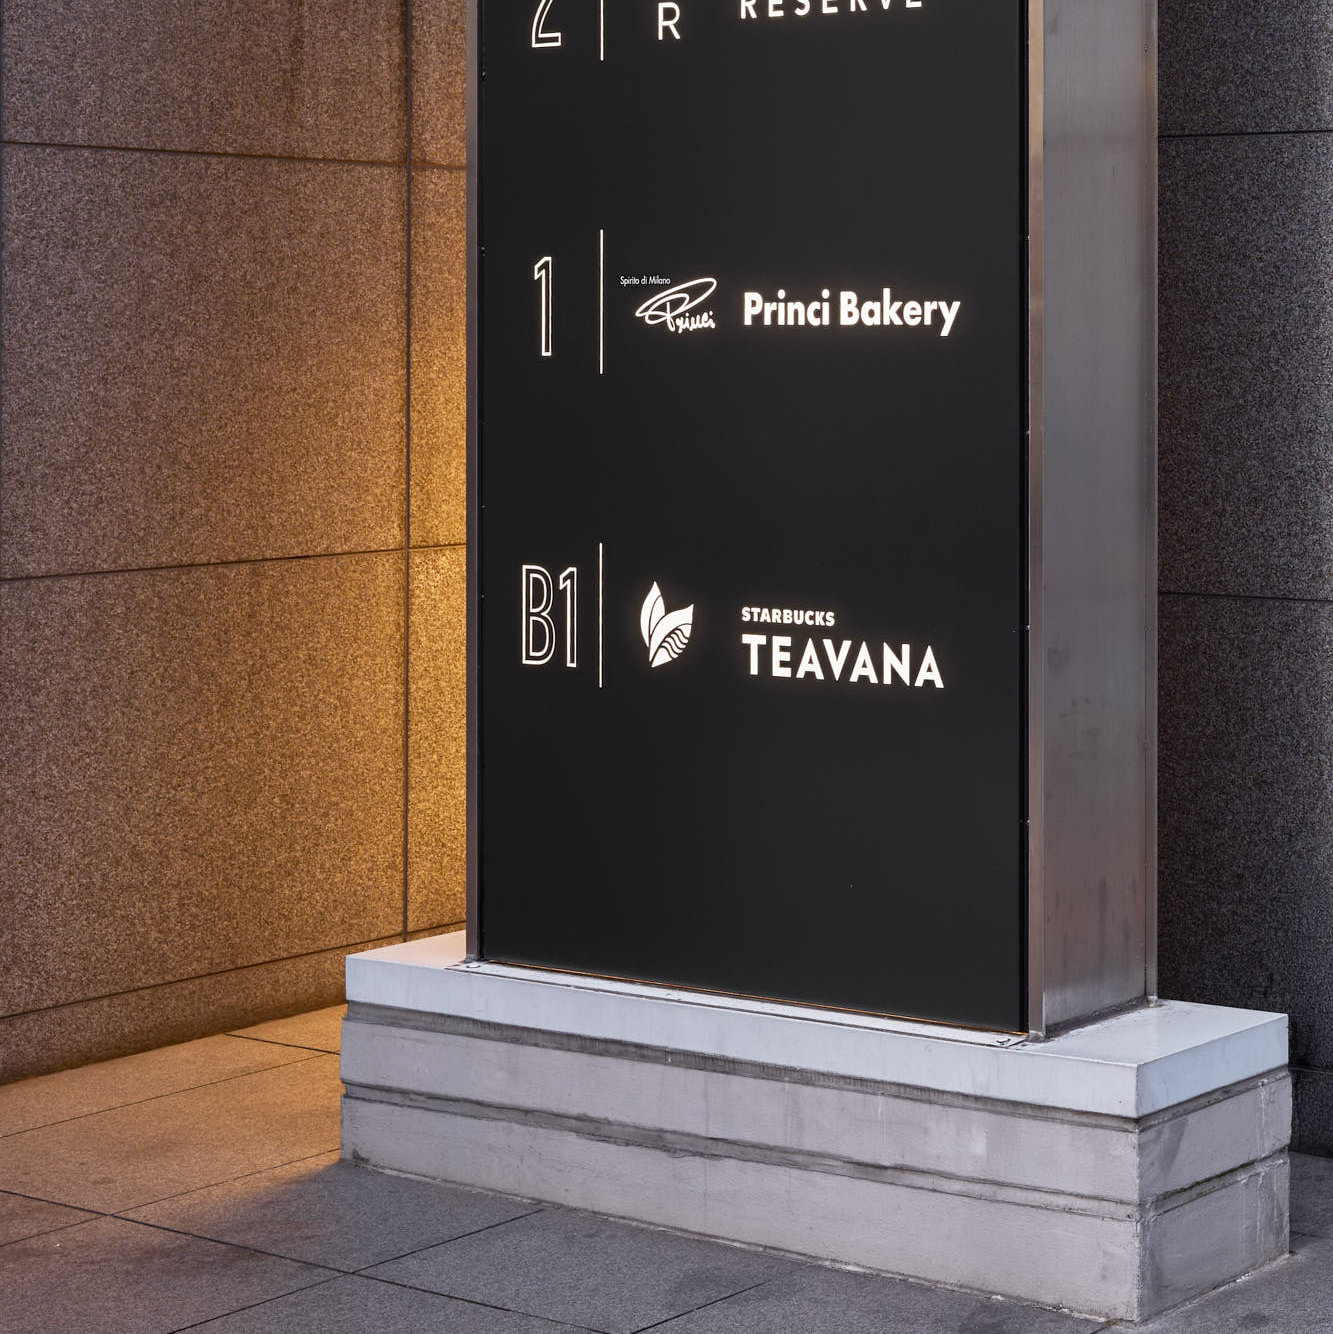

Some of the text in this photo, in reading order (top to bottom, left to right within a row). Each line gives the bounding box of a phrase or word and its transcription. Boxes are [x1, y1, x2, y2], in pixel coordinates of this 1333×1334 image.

[657, 1, 681, 41] R
[620, 275, 671, 287] Spirito di Milano
[533, 256, 553, 357] 1
[743, 287, 961, 337] Princi Bakery
[521, 564, 578, 668] B1
[741, 606, 836, 627] STARBUCKS
[741, 633, 945, 689] TEAVANA
